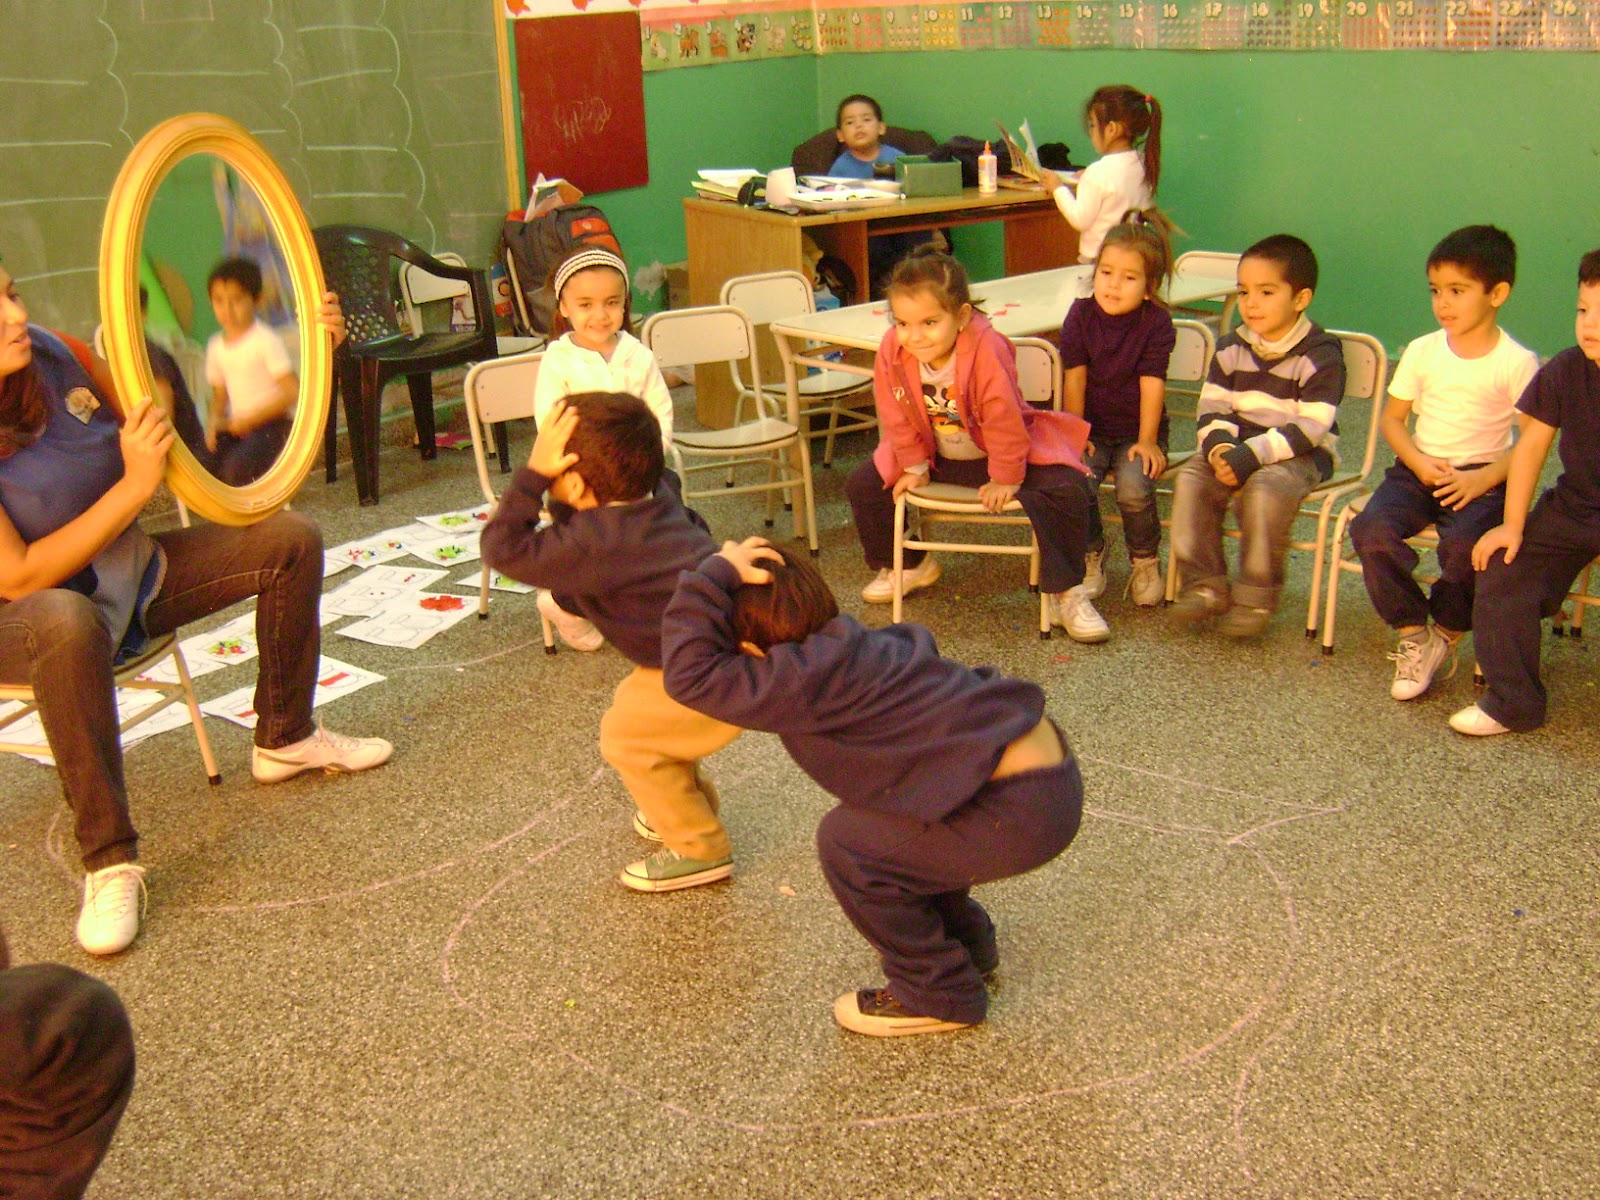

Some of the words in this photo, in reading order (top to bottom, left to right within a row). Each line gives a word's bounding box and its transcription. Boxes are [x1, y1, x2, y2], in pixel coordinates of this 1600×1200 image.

[924, 8, 939, 23] 10
[961, 7, 974, 21] 11
[998, 6, 1013, 19] 12
[1037, 5, 1052, 19] 13
[1076, 5, 1093, 18] 14
[1119, 4, 1134, 18] 15
[1163, 4, 1178, 18] 16
[1205, 2, 1223, 17] 17
[1251, 2, 1268, 17] 18
[1297, 3, 1314, 18] 19
[1346, 1, 1368, 16] 20
[1396, 1, 1415, 16] 21
[1444, 0, 1467, 17] 22
[1499, 0, 1522, 17] 23
[1552, 0, 1577, 16] 24
